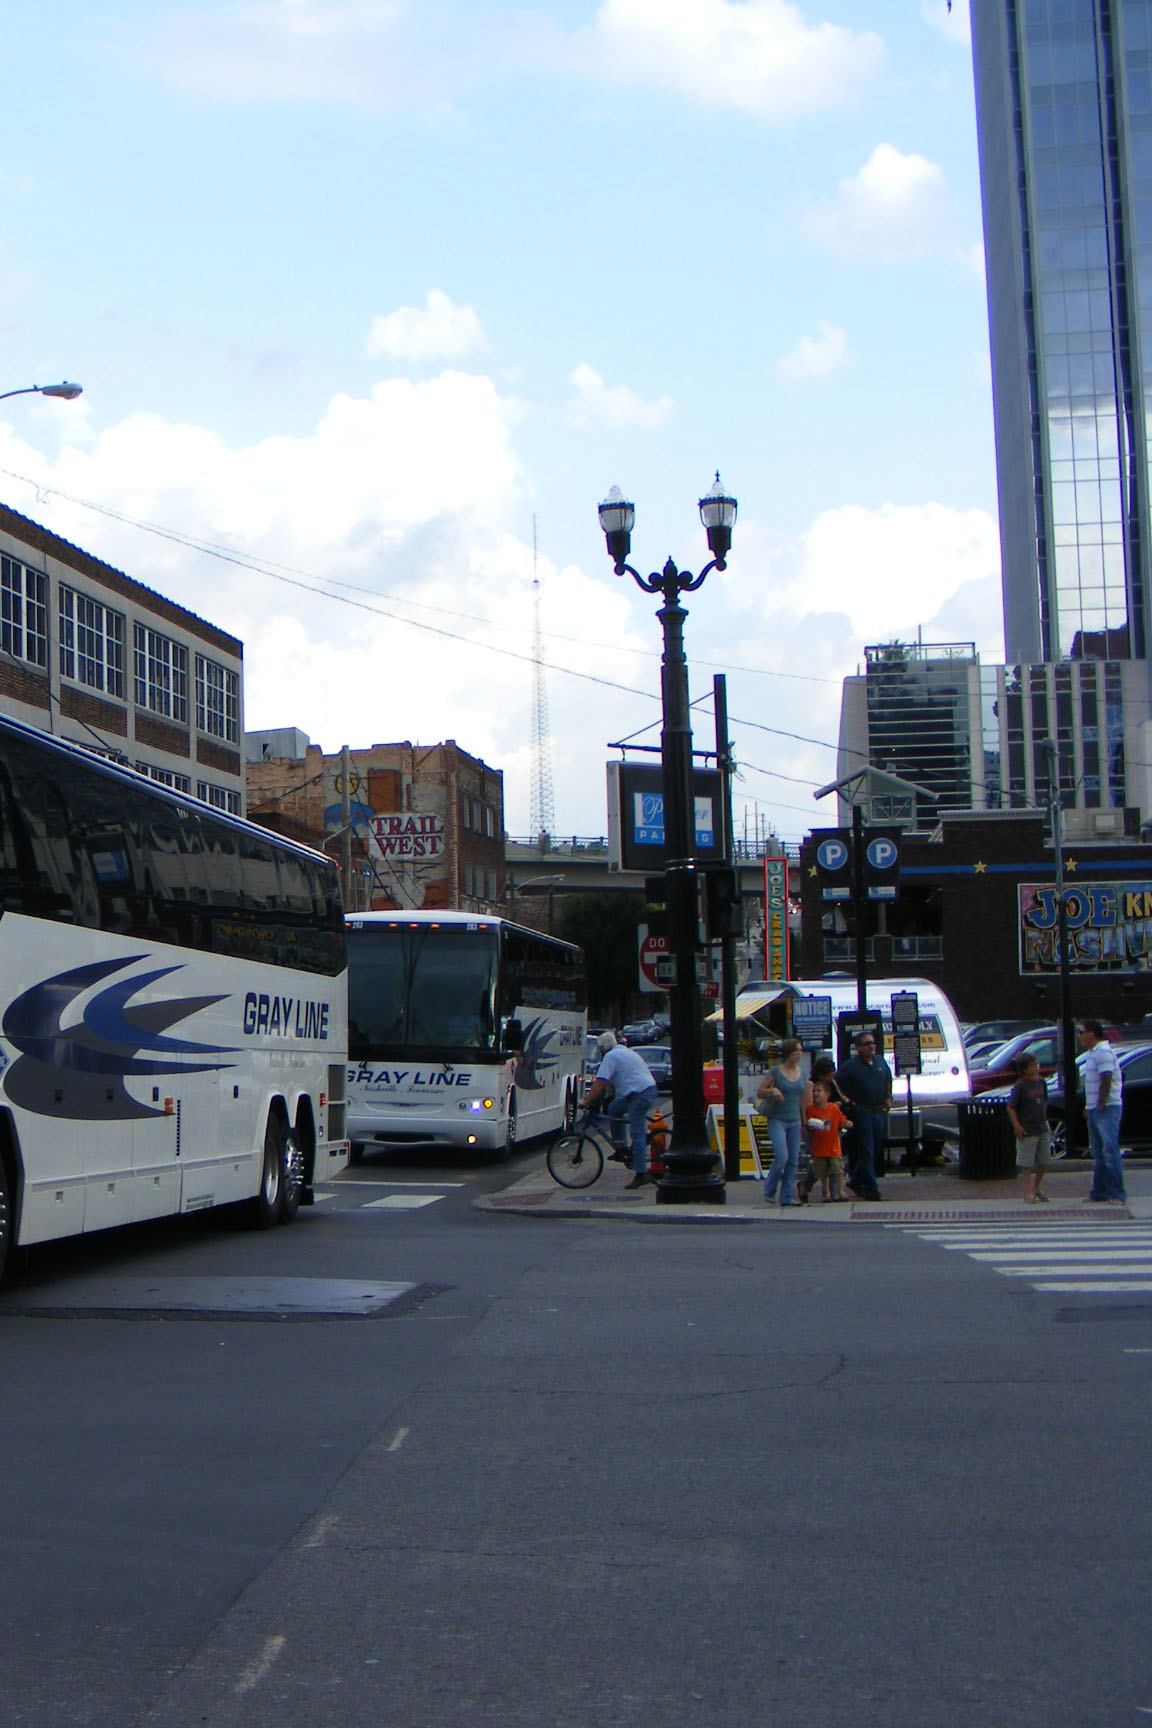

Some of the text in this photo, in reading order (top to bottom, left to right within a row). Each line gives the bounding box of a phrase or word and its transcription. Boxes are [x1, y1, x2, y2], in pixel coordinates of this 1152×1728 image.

[370, 815, 444, 836] TRAIL
[375, 835, 442, 857] WEST
[1026, 887, 1117, 929] JOE
[649, 937, 666, 948] DO
[243, 991, 329, 1040] GRAY LINE
[795, 1000, 829, 1016] NOTICE
[347, 1069, 472, 1087] GRAY LINE
